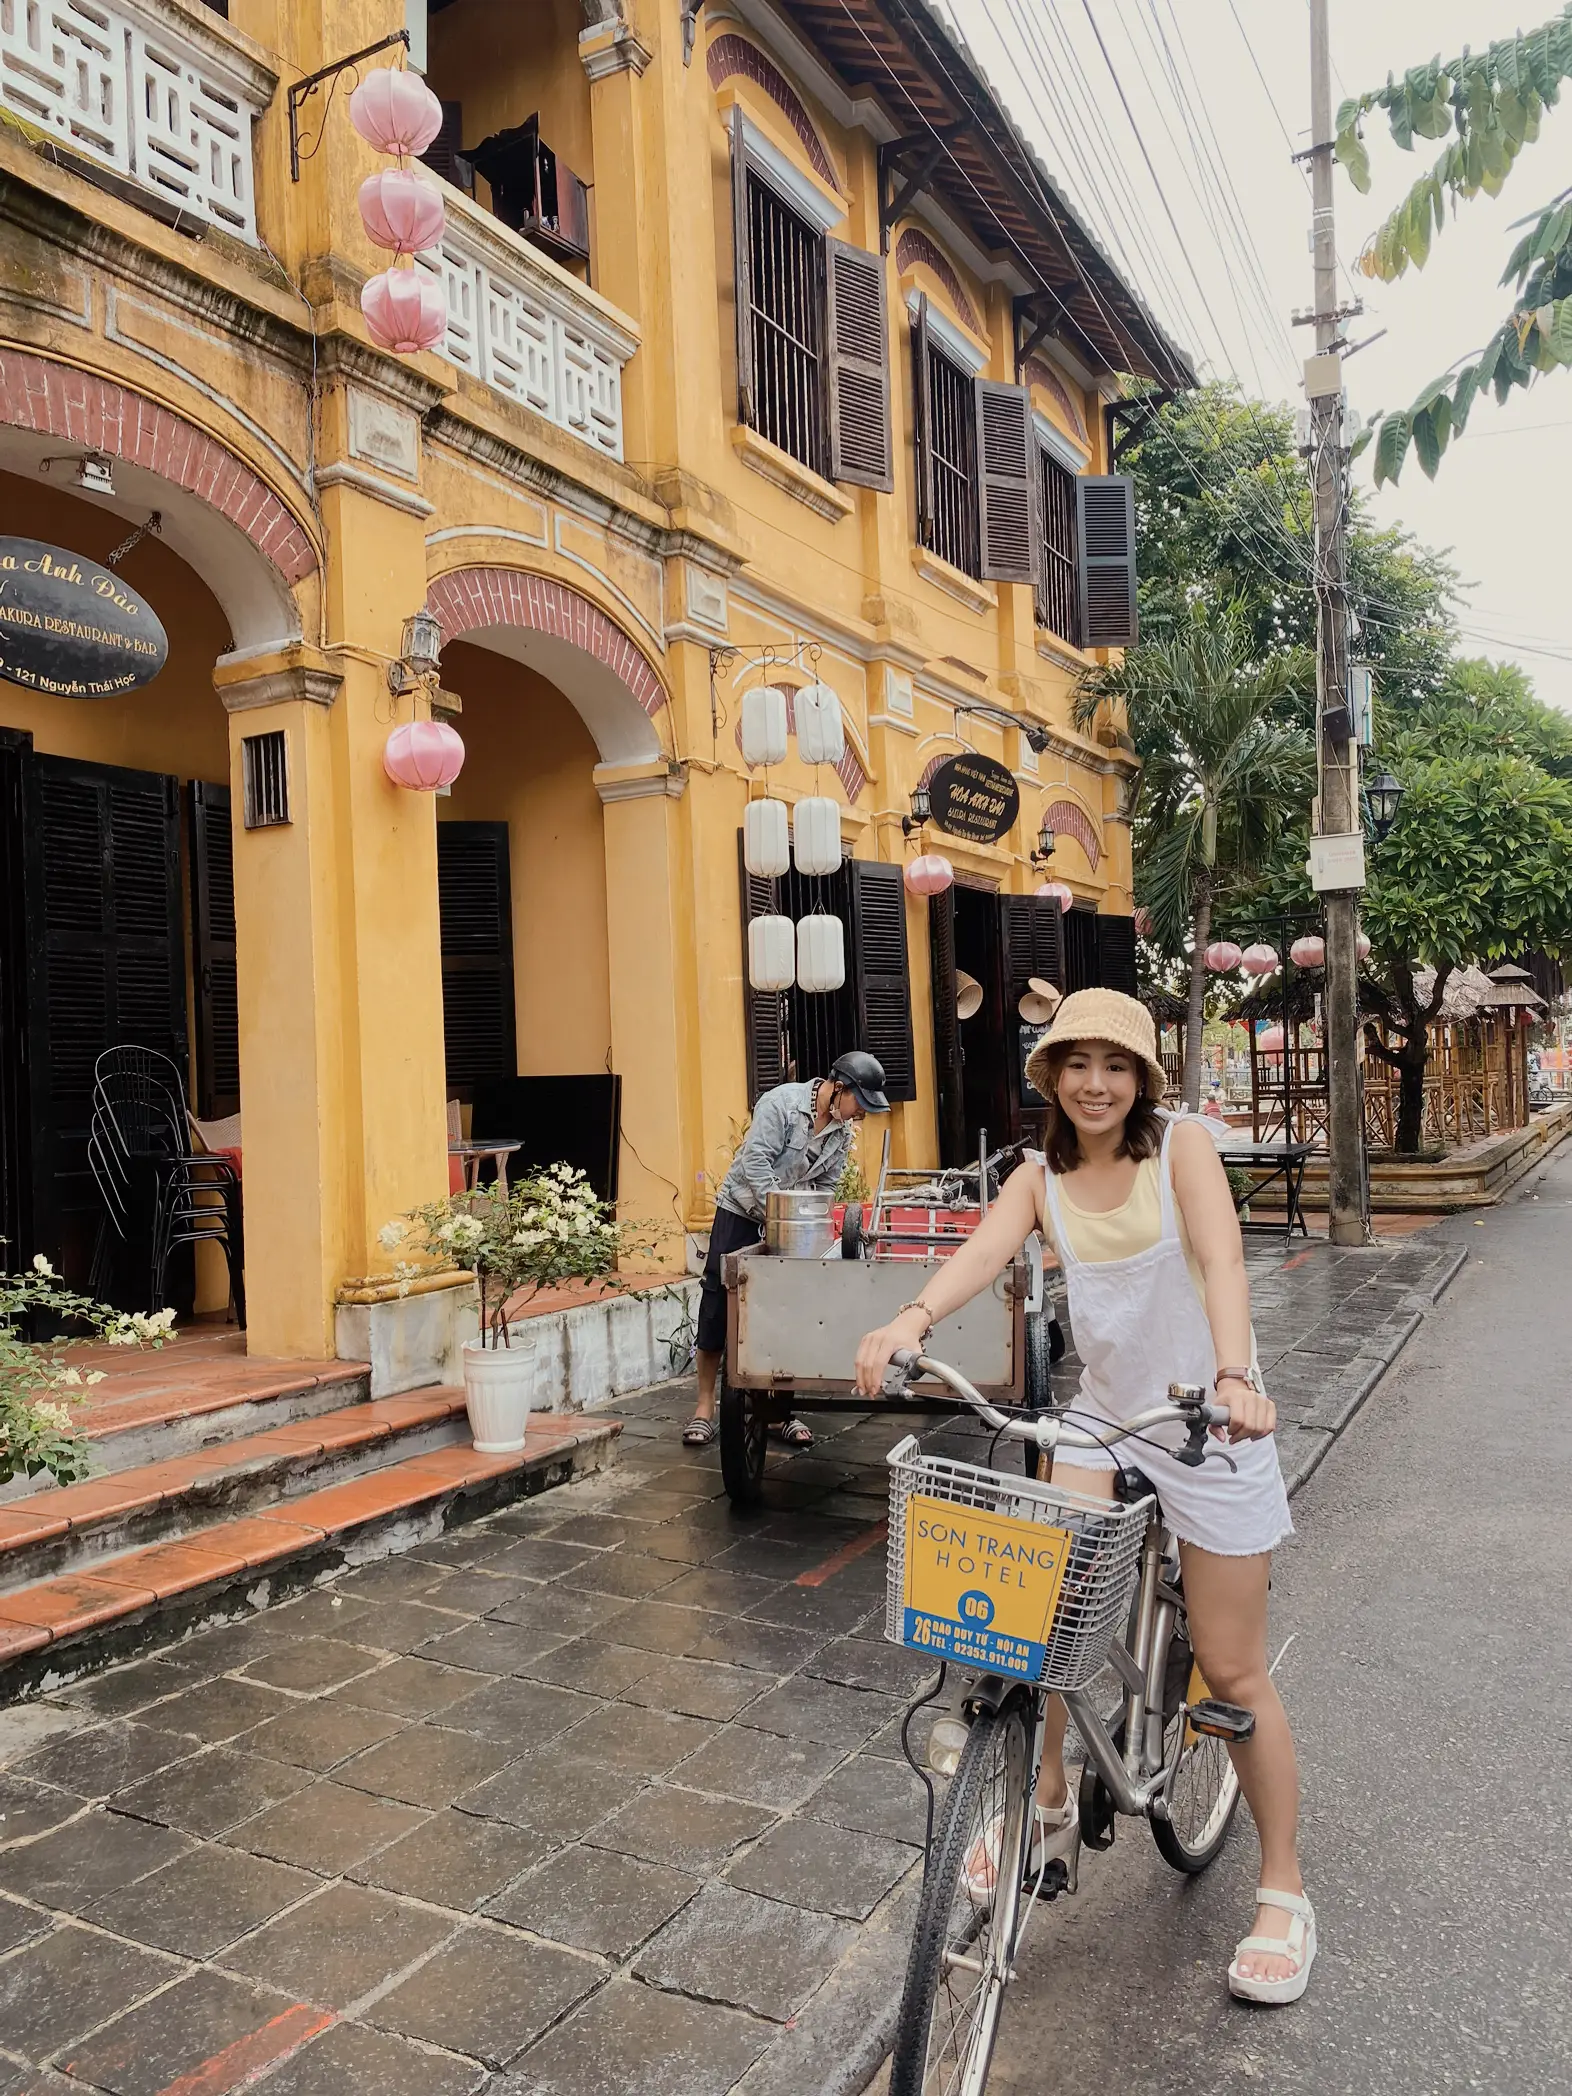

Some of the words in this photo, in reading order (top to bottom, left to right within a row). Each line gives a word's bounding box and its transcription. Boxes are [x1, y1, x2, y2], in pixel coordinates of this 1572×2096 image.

[24, 553, 84, 586] Anh
[91, 575, 139, 615] Đào
[0, 605, 42, 629] AKURA
[44, 616, 123, 647] RESTAURANT
[134, 638, 158, 657] BAR
[15, 667, 36, 684] 121
[40, 675, 86, 694] Nguyễn
[88, 680, 113, 694] Thái
[115, 672, 136, 688] Học
[936, 1549, 1026, 1589] HOTEL
[976, 1534, 1055, 1570] TRANG
[964, 1597, 989, 1620] 06
[913, 1616, 932, 1645] 26
[953, 1626, 974, 1642] DUY
[1016, 1643, 1029, 1658] AN
